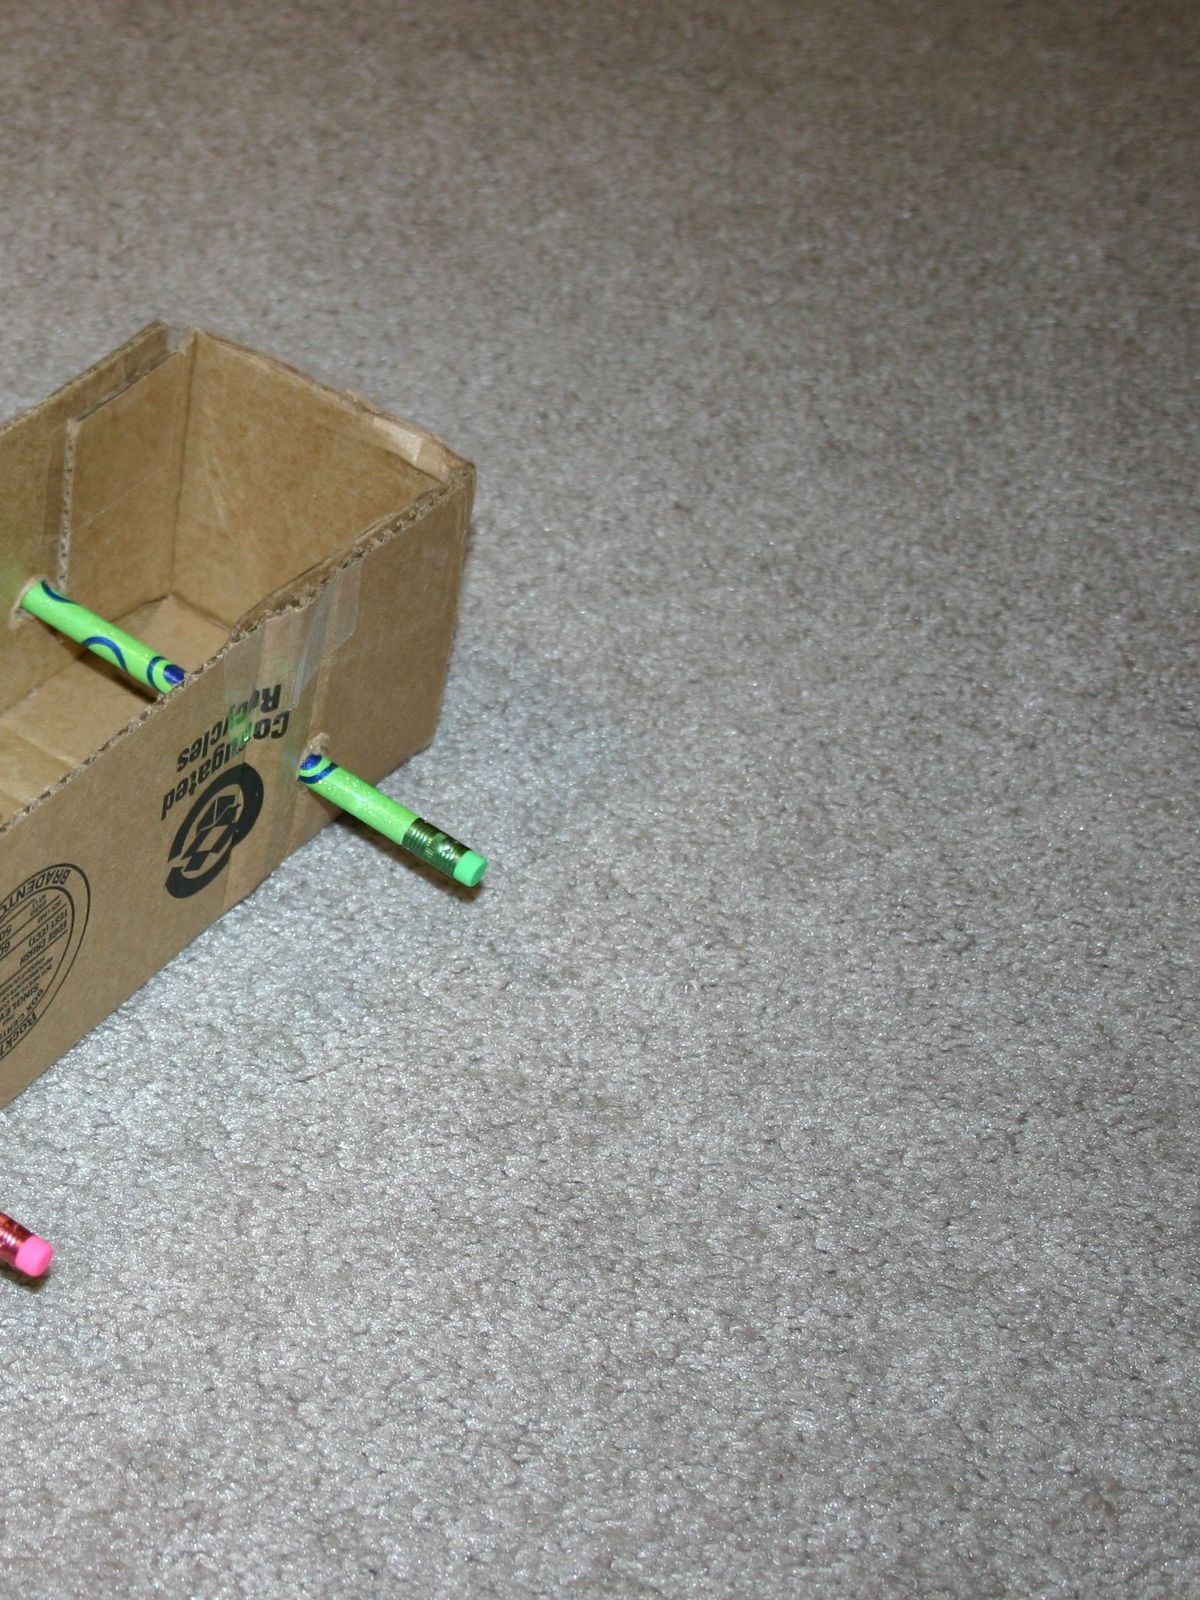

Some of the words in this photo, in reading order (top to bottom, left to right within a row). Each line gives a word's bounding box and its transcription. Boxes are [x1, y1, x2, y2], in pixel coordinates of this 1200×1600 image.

[161, 712, 289, 820] Cougated
[51, 910, 67, 929] TEST
[0, 925, 12, 942] 50
[48, 920, 67, 942] EDGE
[20, 939, 46, 966] CRUSH
